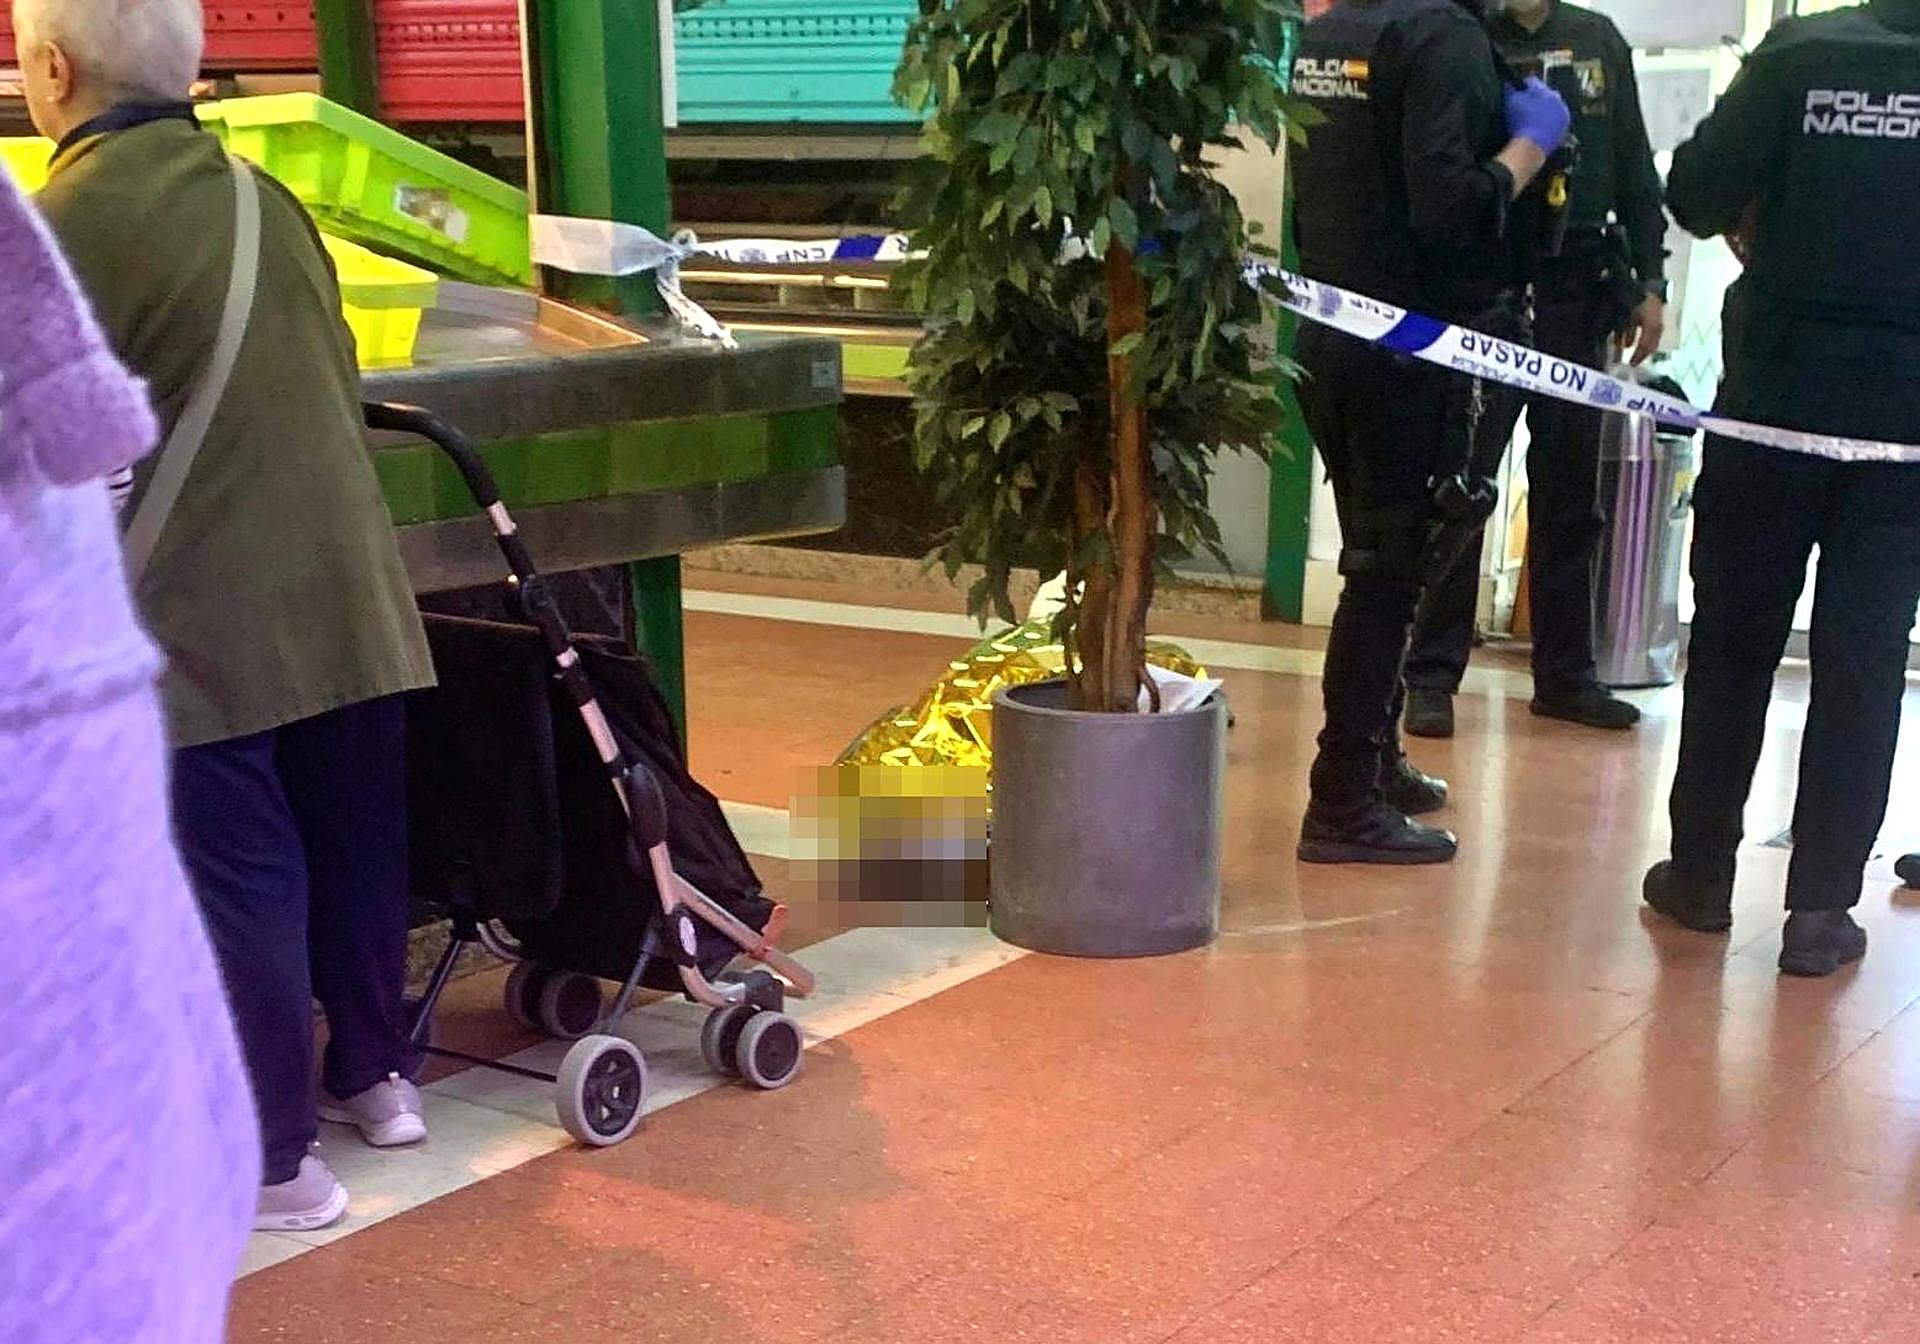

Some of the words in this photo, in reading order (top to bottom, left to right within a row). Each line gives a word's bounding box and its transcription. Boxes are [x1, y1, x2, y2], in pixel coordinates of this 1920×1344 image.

[1292, 78, 1368, 100] NACIONAL
[1460, 332, 1542, 377] PASAR
[1549, 361, 1586, 391] NO
